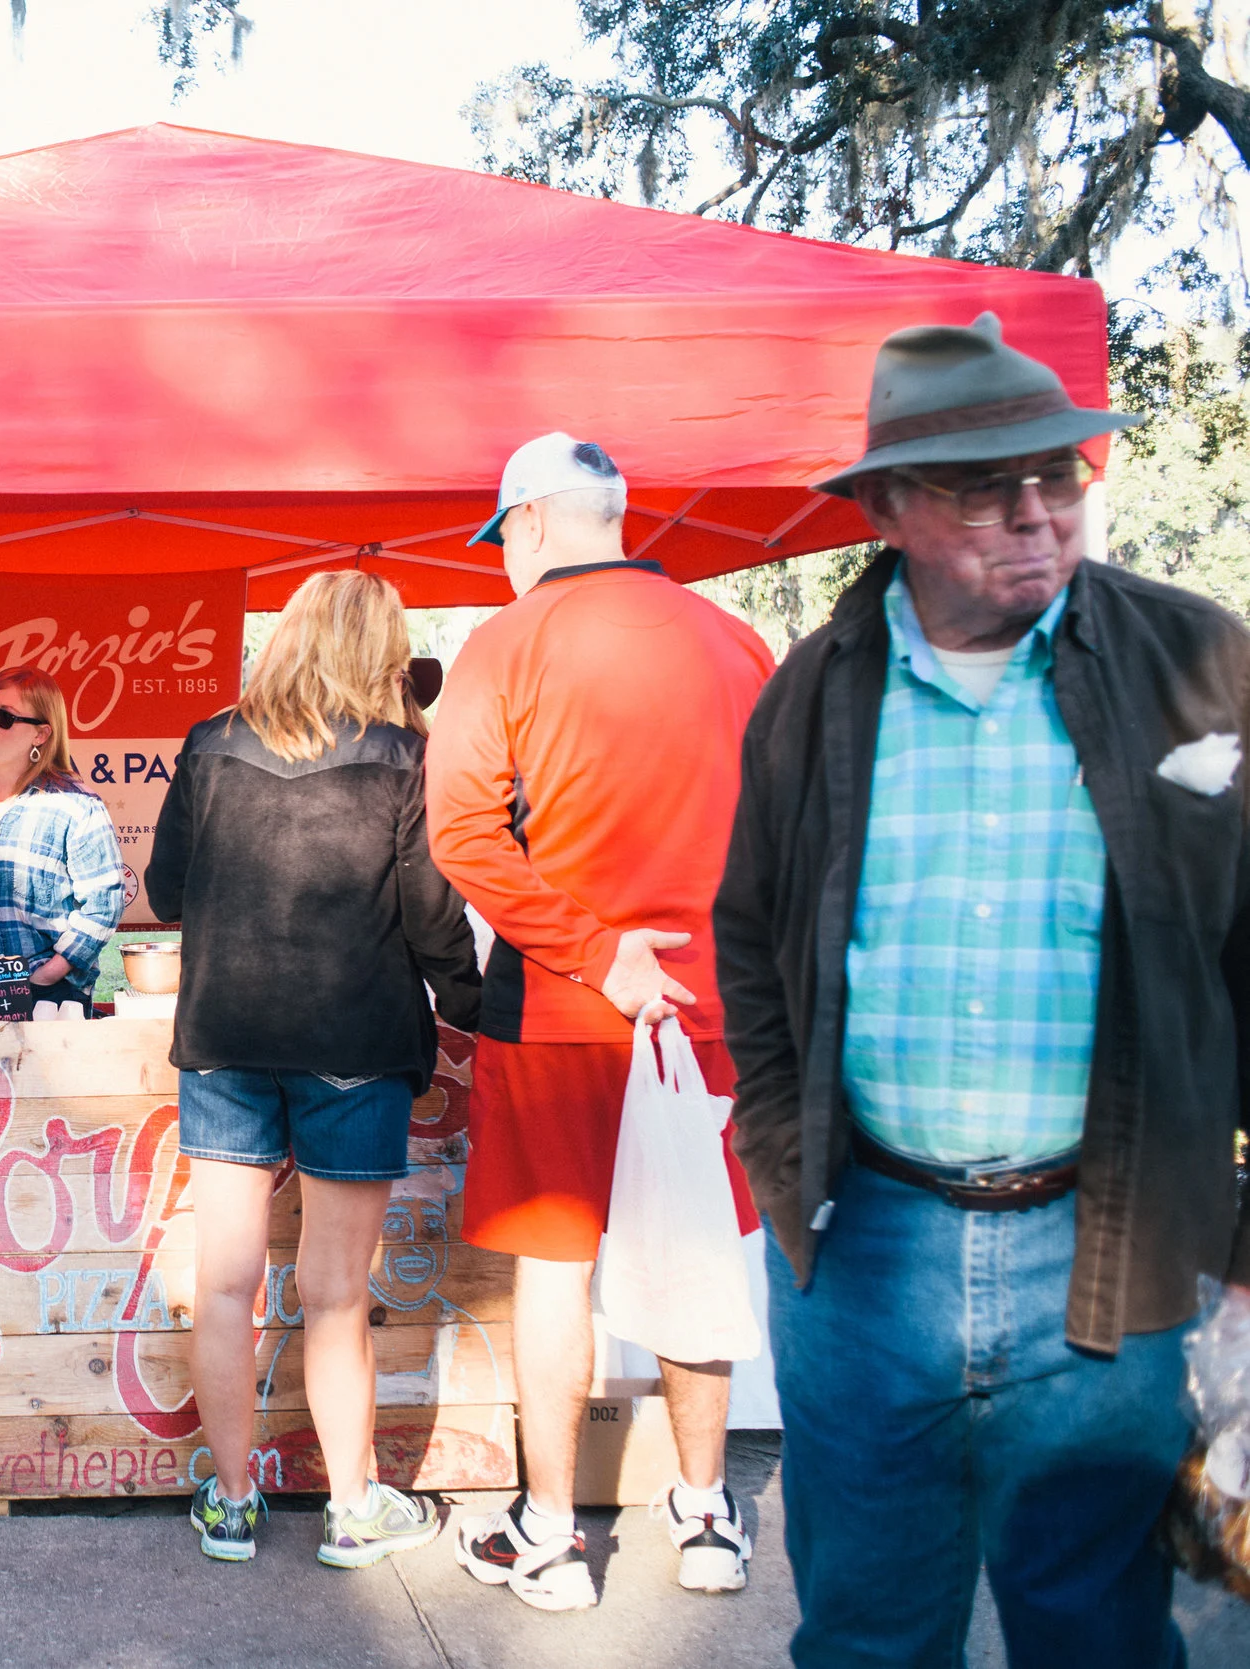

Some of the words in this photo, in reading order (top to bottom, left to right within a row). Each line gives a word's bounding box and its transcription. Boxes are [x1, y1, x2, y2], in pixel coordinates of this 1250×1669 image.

[132, 679, 170, 694] EST.
[177, 678, 218, 694] 1895
[118, 825, 157, 834] YEARS
[10, 985, 30, 995] Herb
[36, 1268, 174, 1333] PIZZA
[590, 1407, 619, 1422] DOZ
